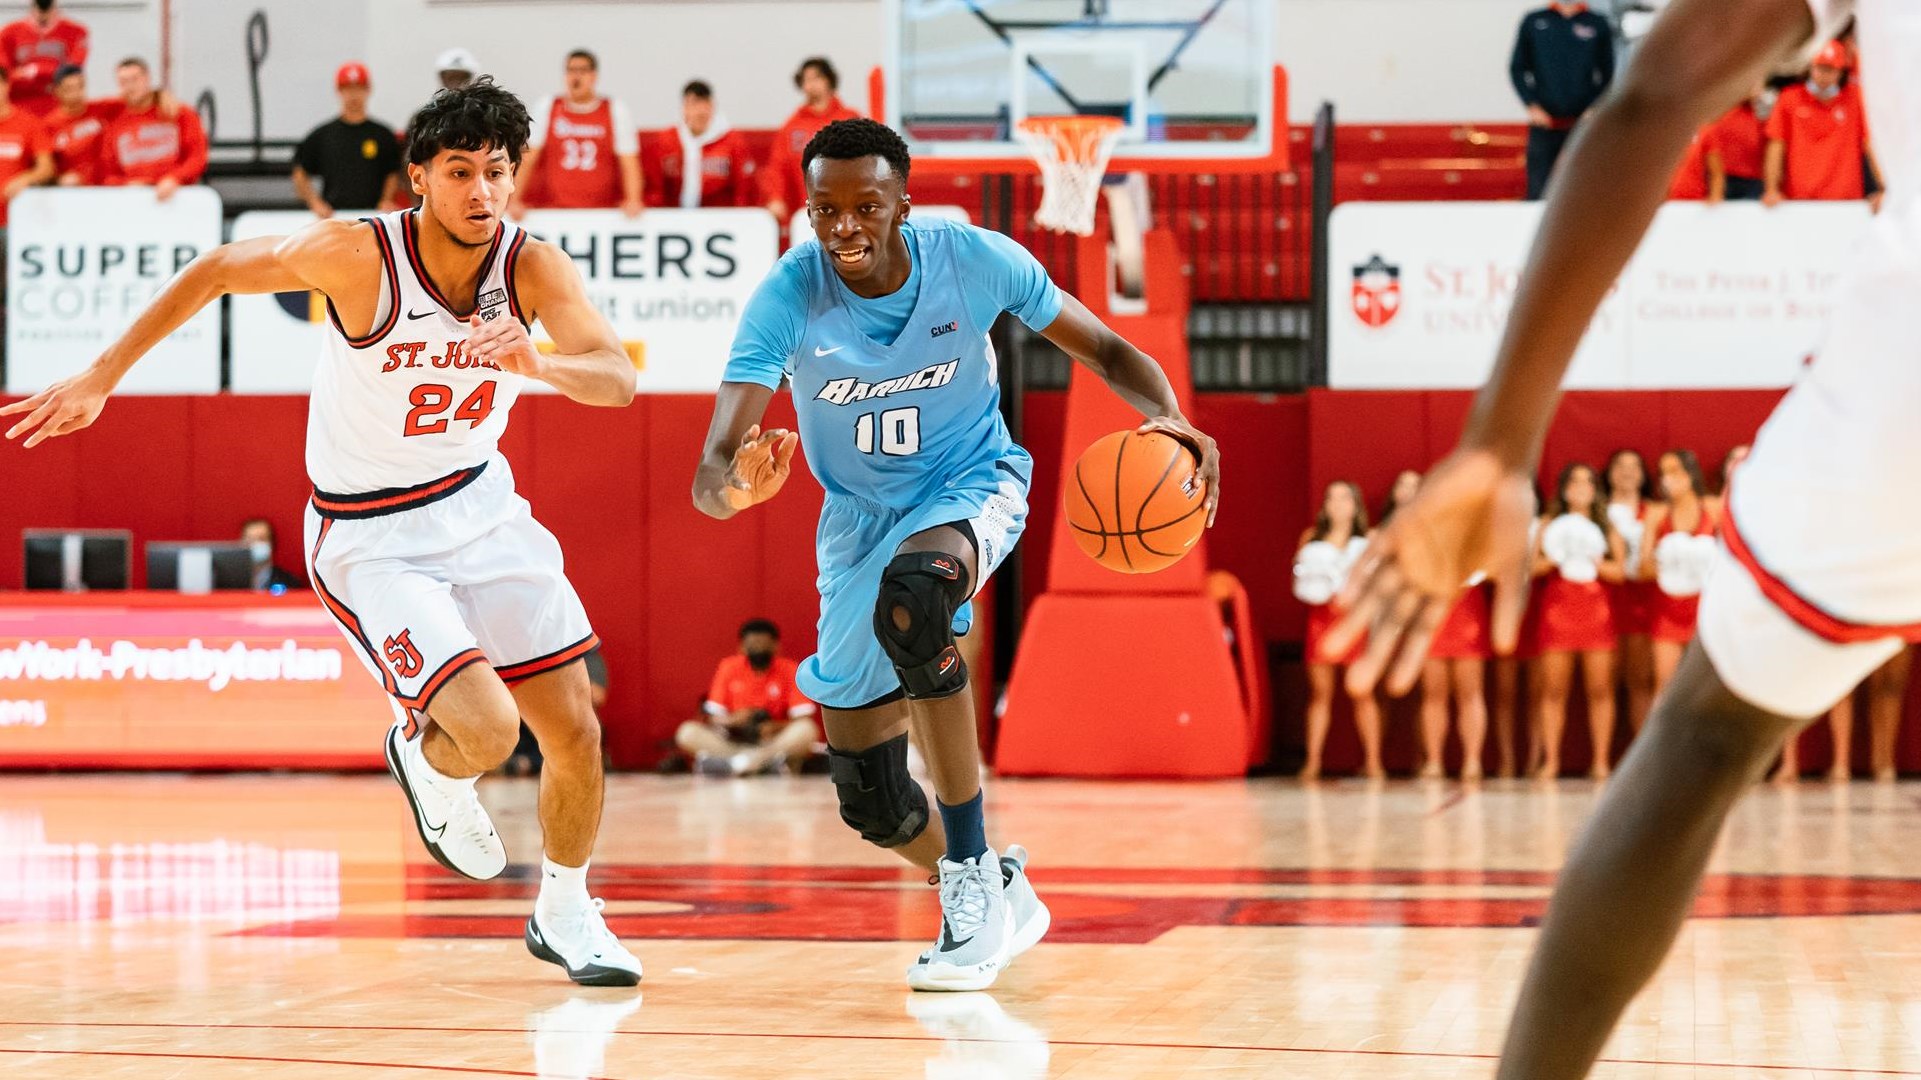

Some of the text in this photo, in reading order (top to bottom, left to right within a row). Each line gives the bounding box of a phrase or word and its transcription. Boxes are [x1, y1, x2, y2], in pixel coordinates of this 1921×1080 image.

[529, 232, 737, 279] HERS
[634, 290, 736, 321] union
[381, 341, 427, 373] ST.
[812, 357, 961, 406] BARUCH
[403, 380, 497, 437] 24
[854, 406, 921, 457] 10
